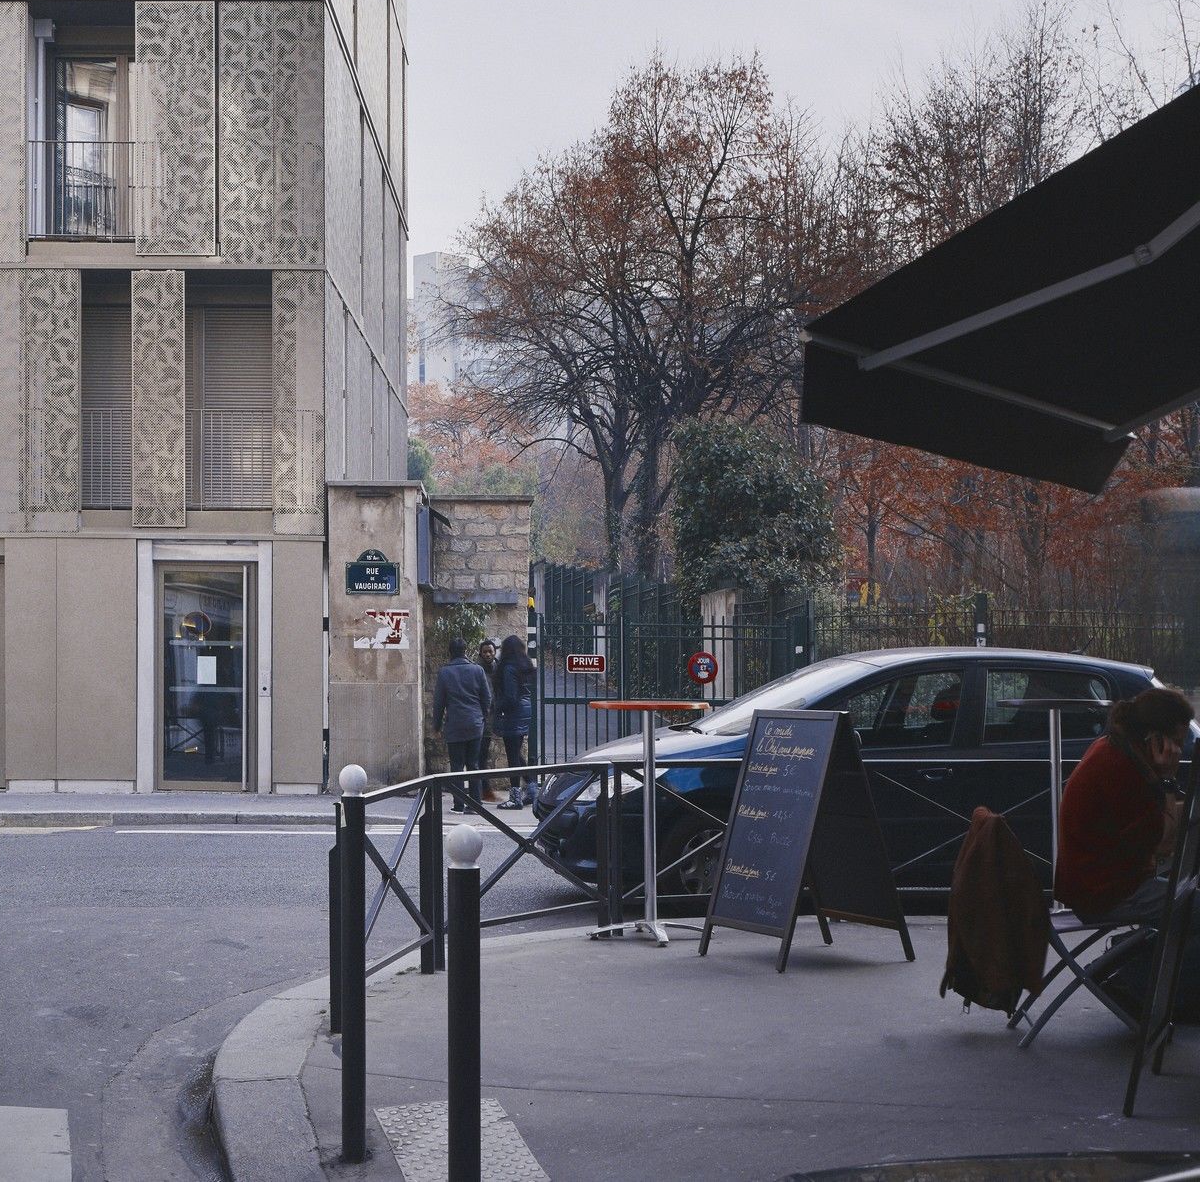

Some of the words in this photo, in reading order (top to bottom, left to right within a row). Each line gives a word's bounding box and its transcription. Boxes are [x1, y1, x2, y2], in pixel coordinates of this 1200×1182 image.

[365, 567, 380, 575] RUE
[354, 582, 391, 590] VAUGIRARD
[573, 657, 600, 666] PRIVE
